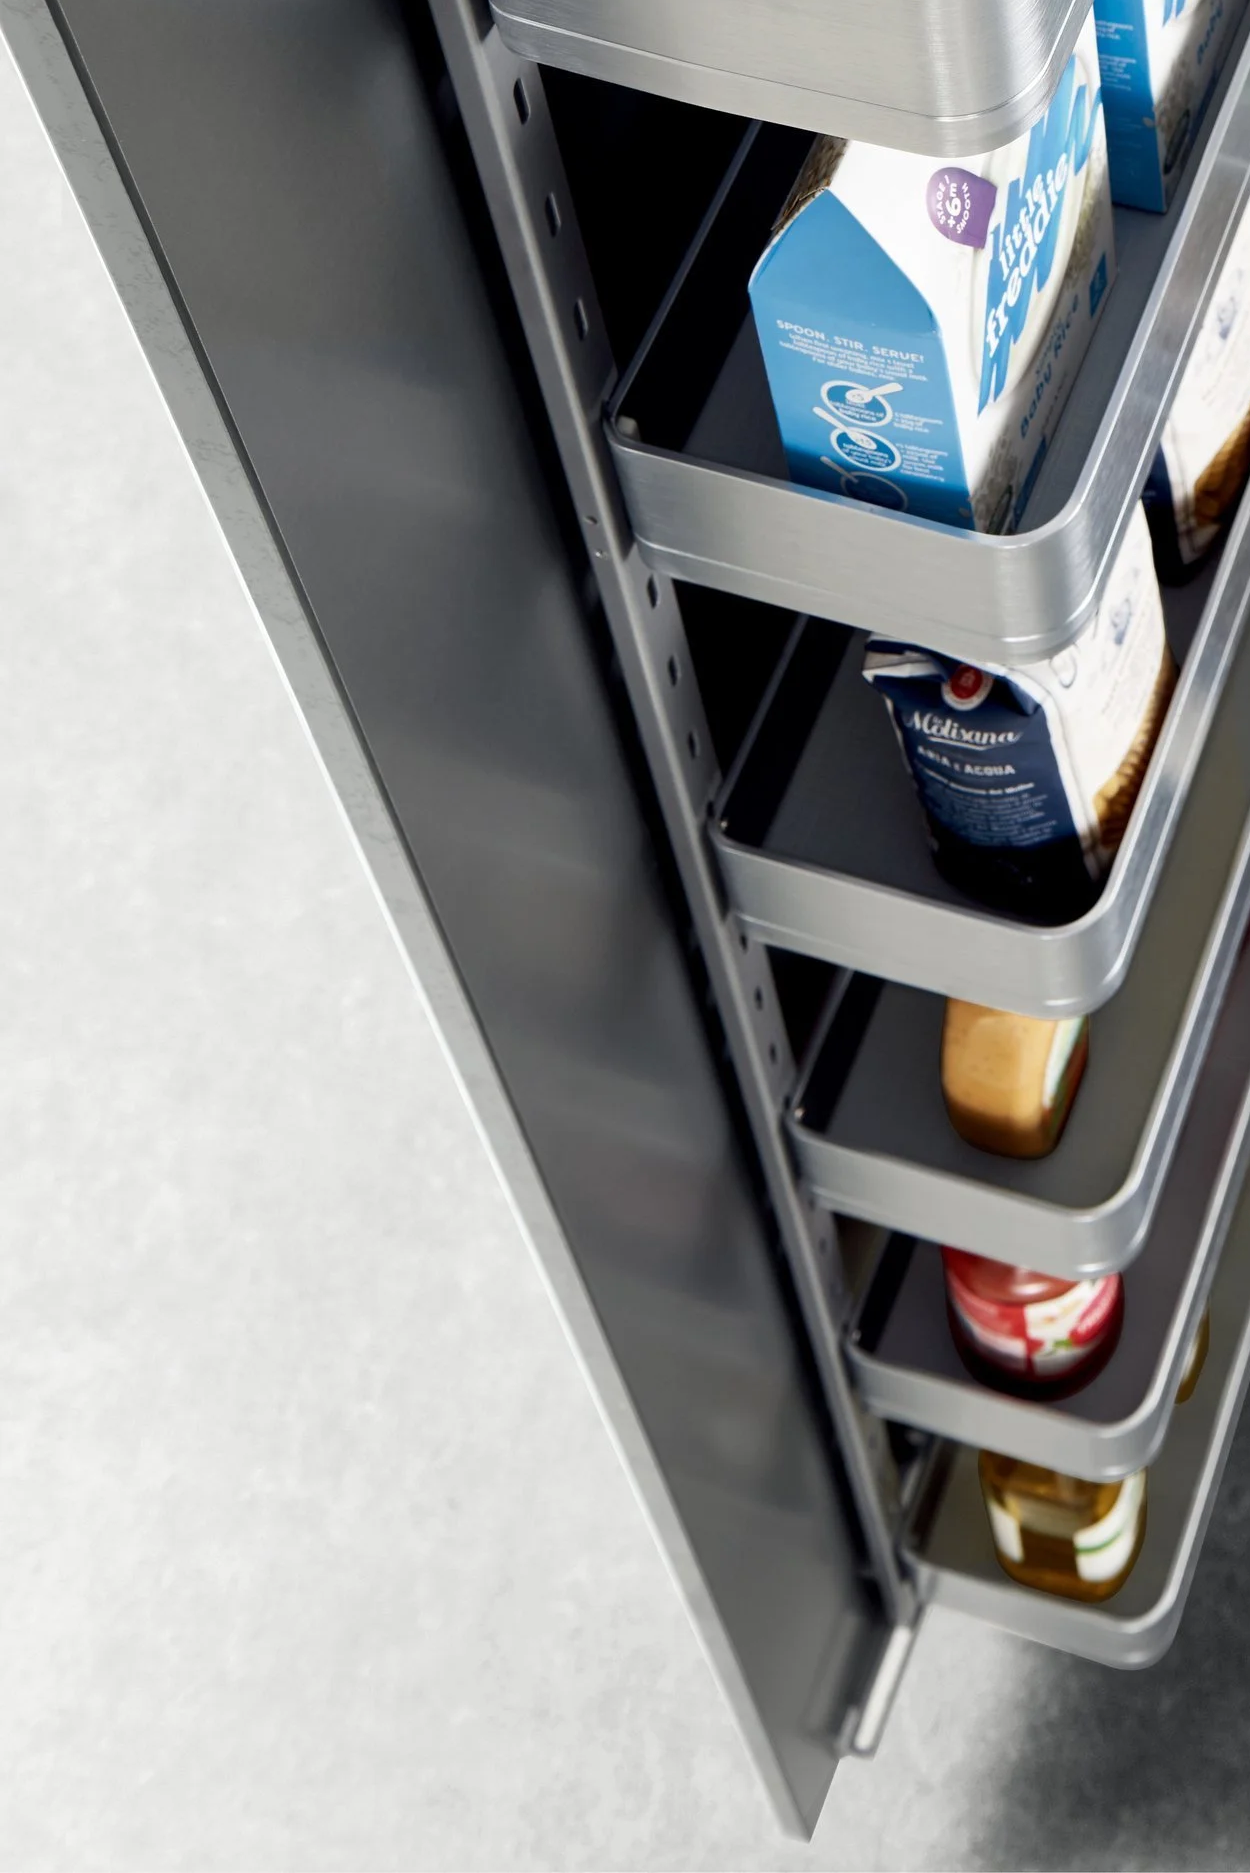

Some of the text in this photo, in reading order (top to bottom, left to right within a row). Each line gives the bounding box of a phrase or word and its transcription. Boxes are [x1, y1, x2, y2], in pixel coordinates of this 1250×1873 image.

[936, 182, 946, 225] STAGE
[956, 182, 972, 235] SMOOTH
[1000, 173, 1048, 282] little
[986, 153, 1069, 359] freddie
[776, 319, 868, 353] SPOON. STIR.
